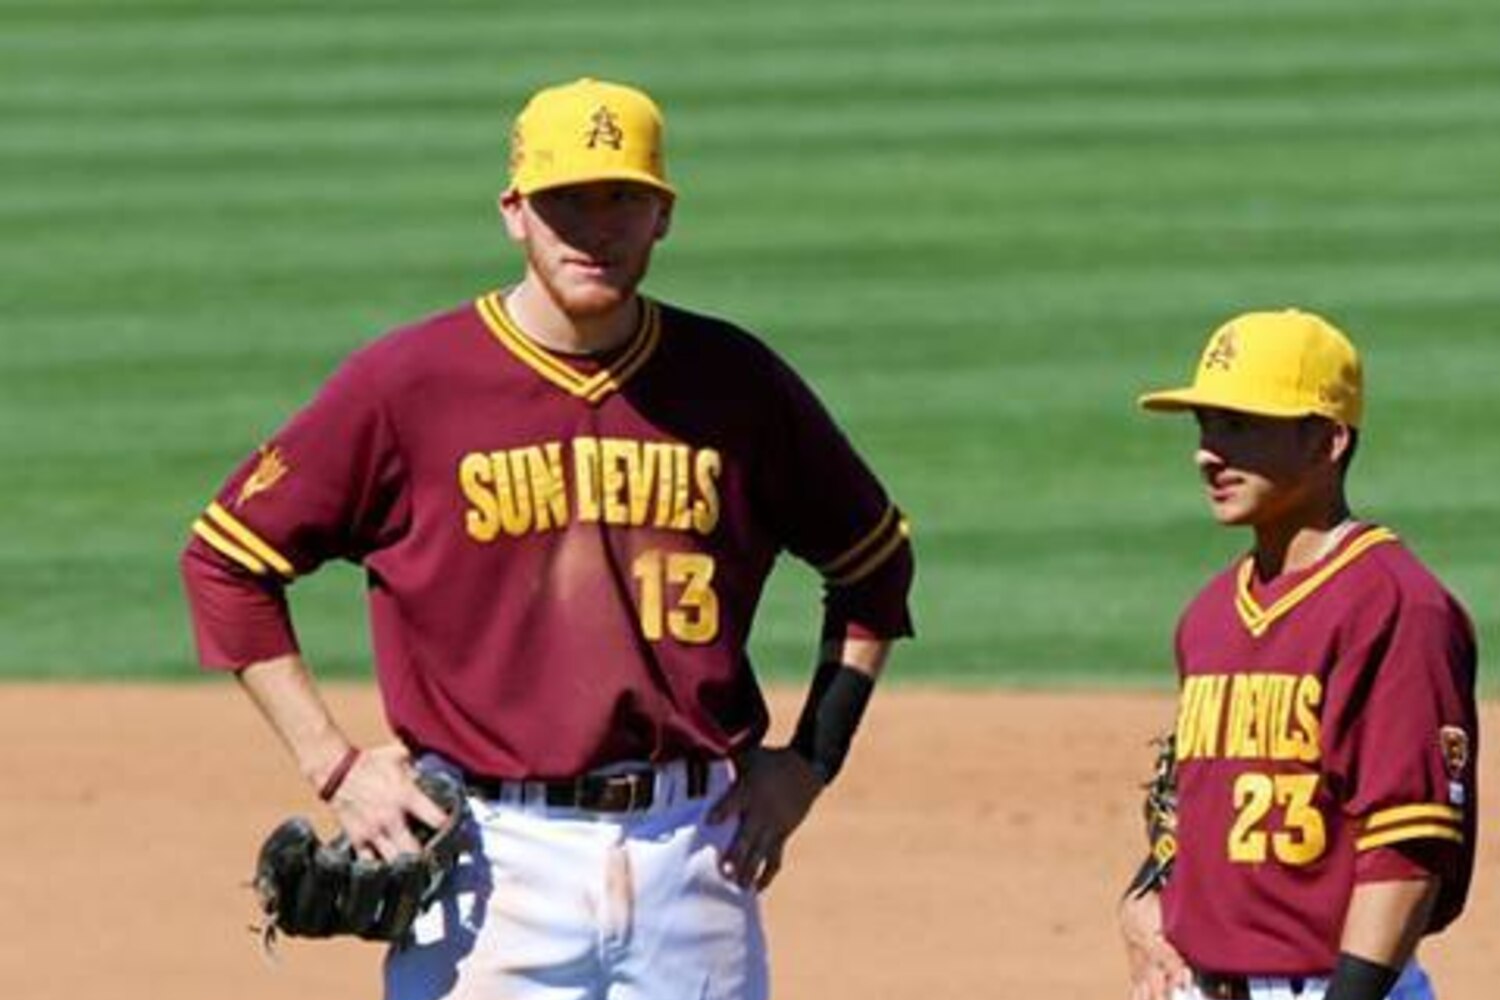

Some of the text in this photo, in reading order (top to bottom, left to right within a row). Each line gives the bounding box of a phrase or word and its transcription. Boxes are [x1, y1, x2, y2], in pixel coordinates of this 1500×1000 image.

[458, 436, 721, 543] SUN DEVILS
[631, 549, 720, 645] 13
[1176, 673, 1323, 764] UN DEVILS
[1227, 772, 1327, 866] 23
